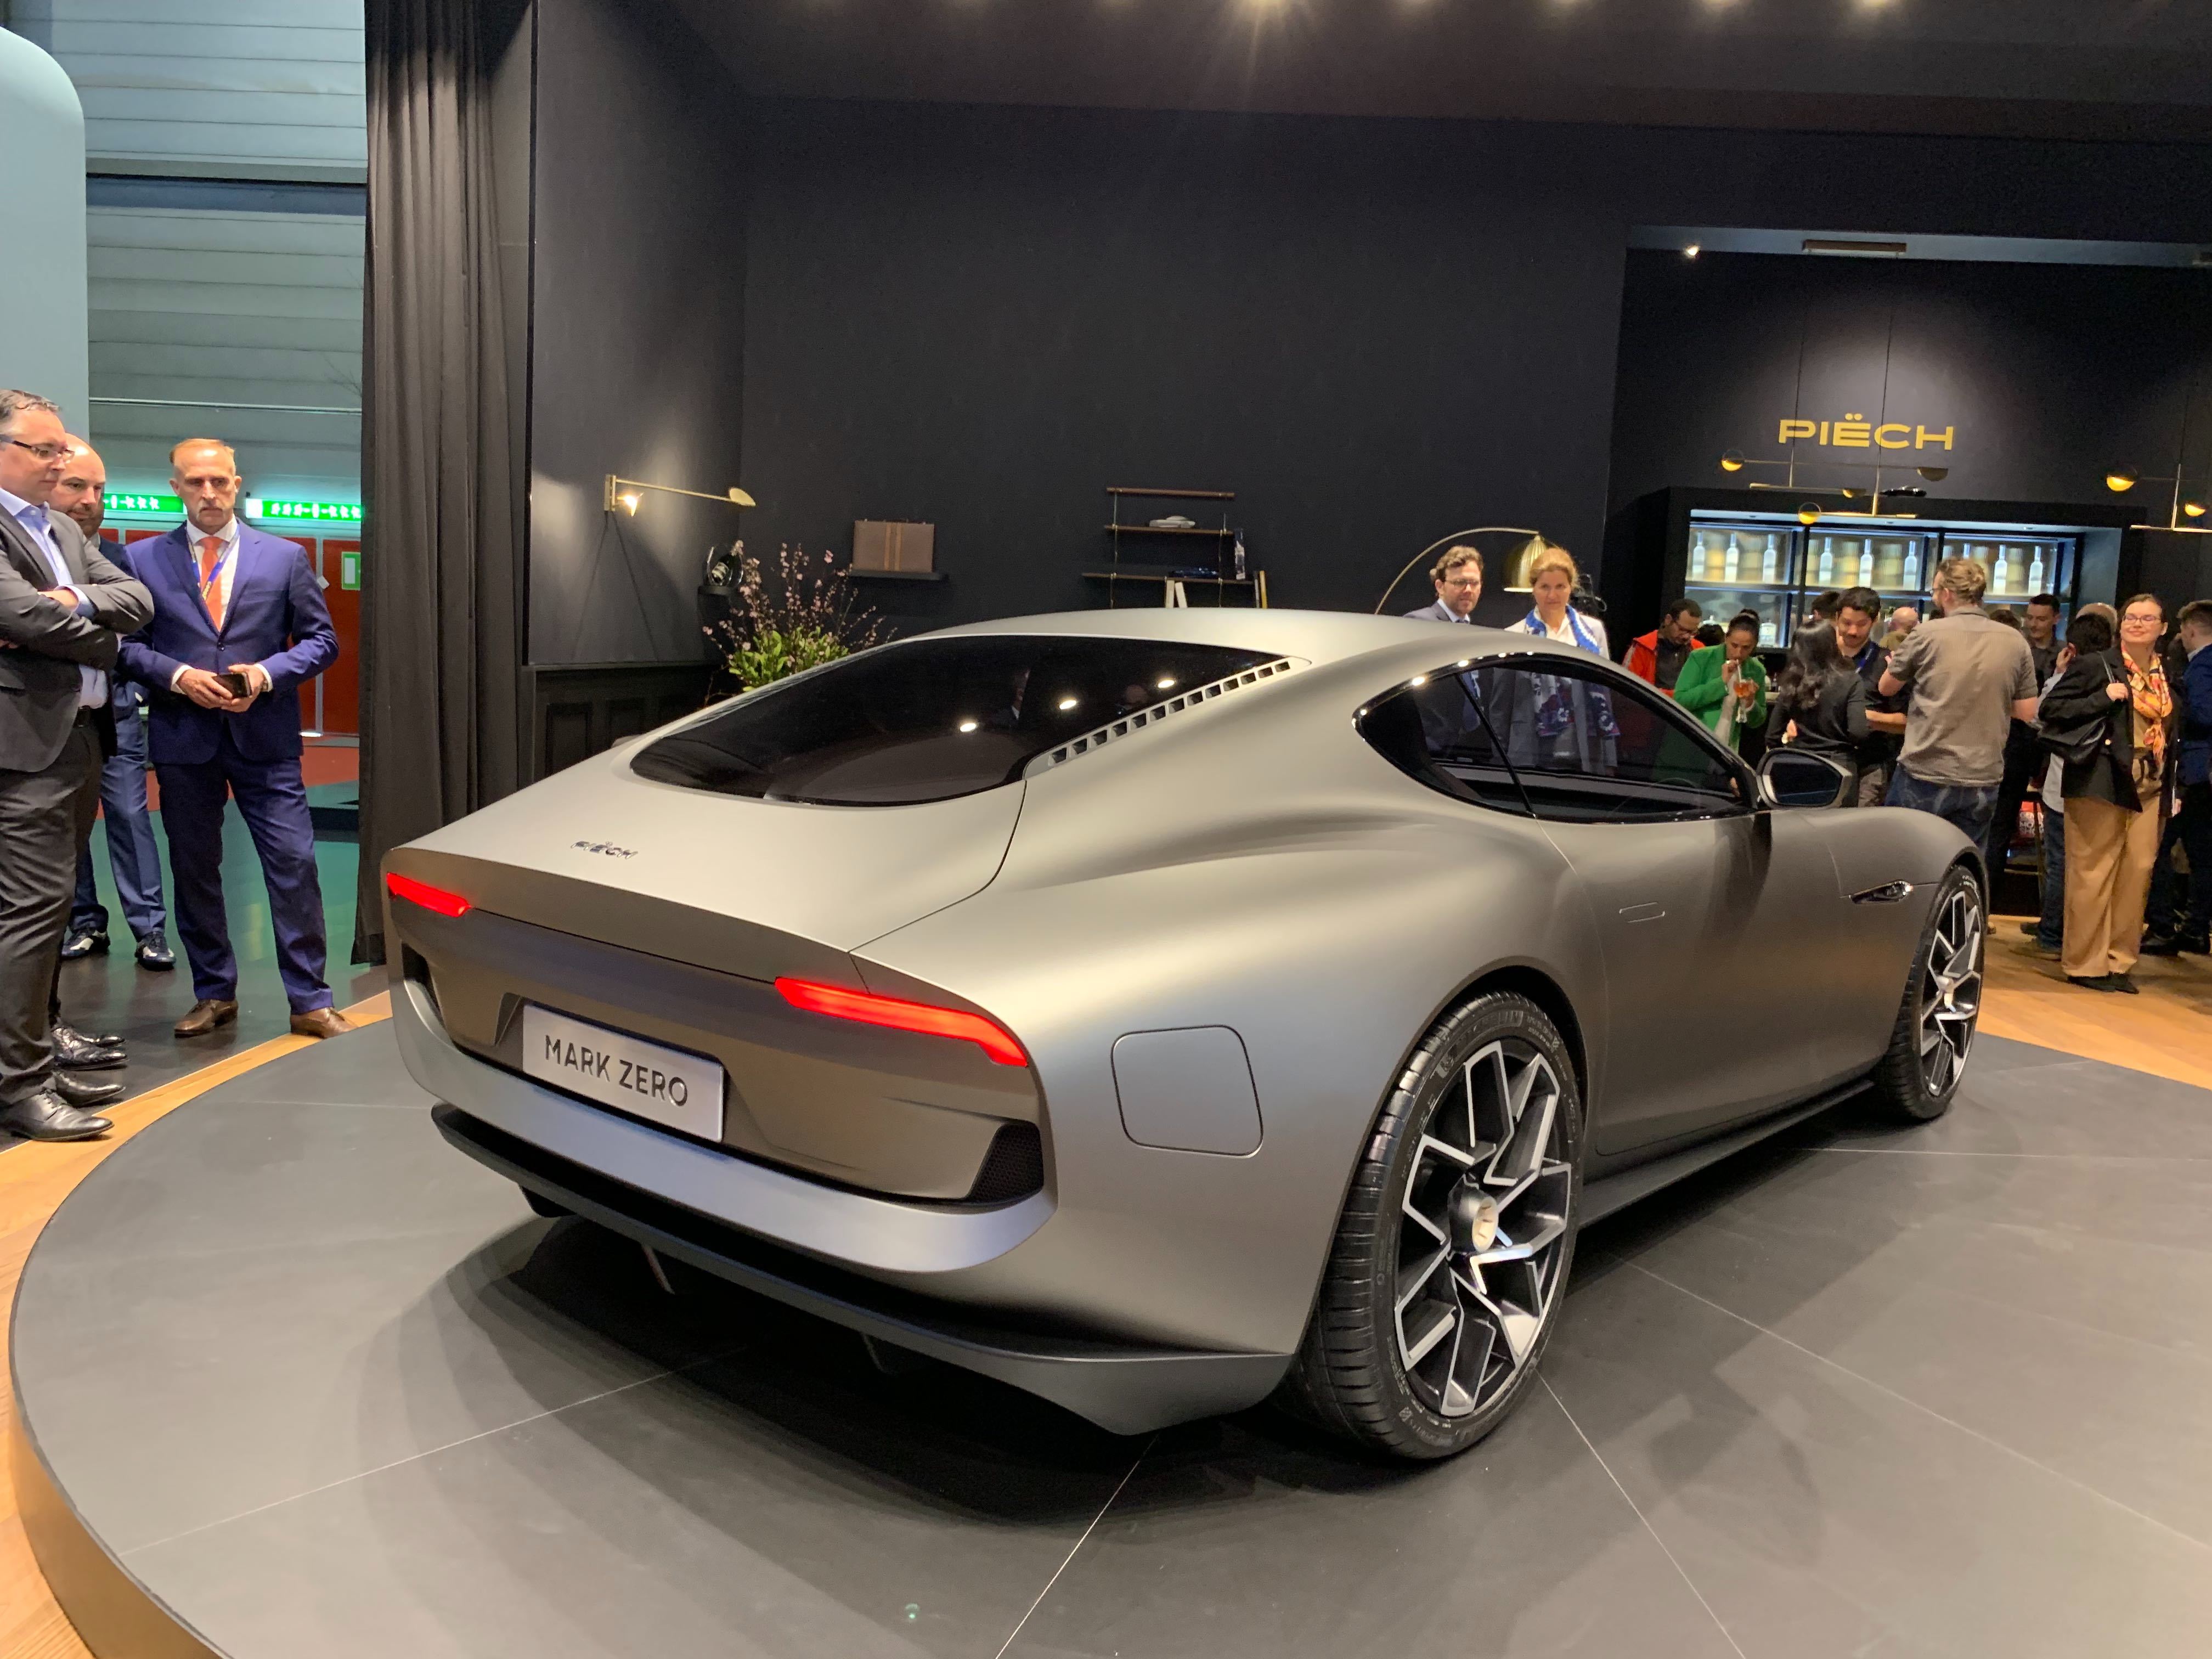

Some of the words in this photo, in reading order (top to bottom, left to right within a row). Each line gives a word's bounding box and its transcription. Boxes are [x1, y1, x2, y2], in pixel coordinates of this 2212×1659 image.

[1779, 413, 1954, 450] PIËCH
[545, 1035, 610, 1082] MARK
[619, 1059, 688, 1107] ZERO
